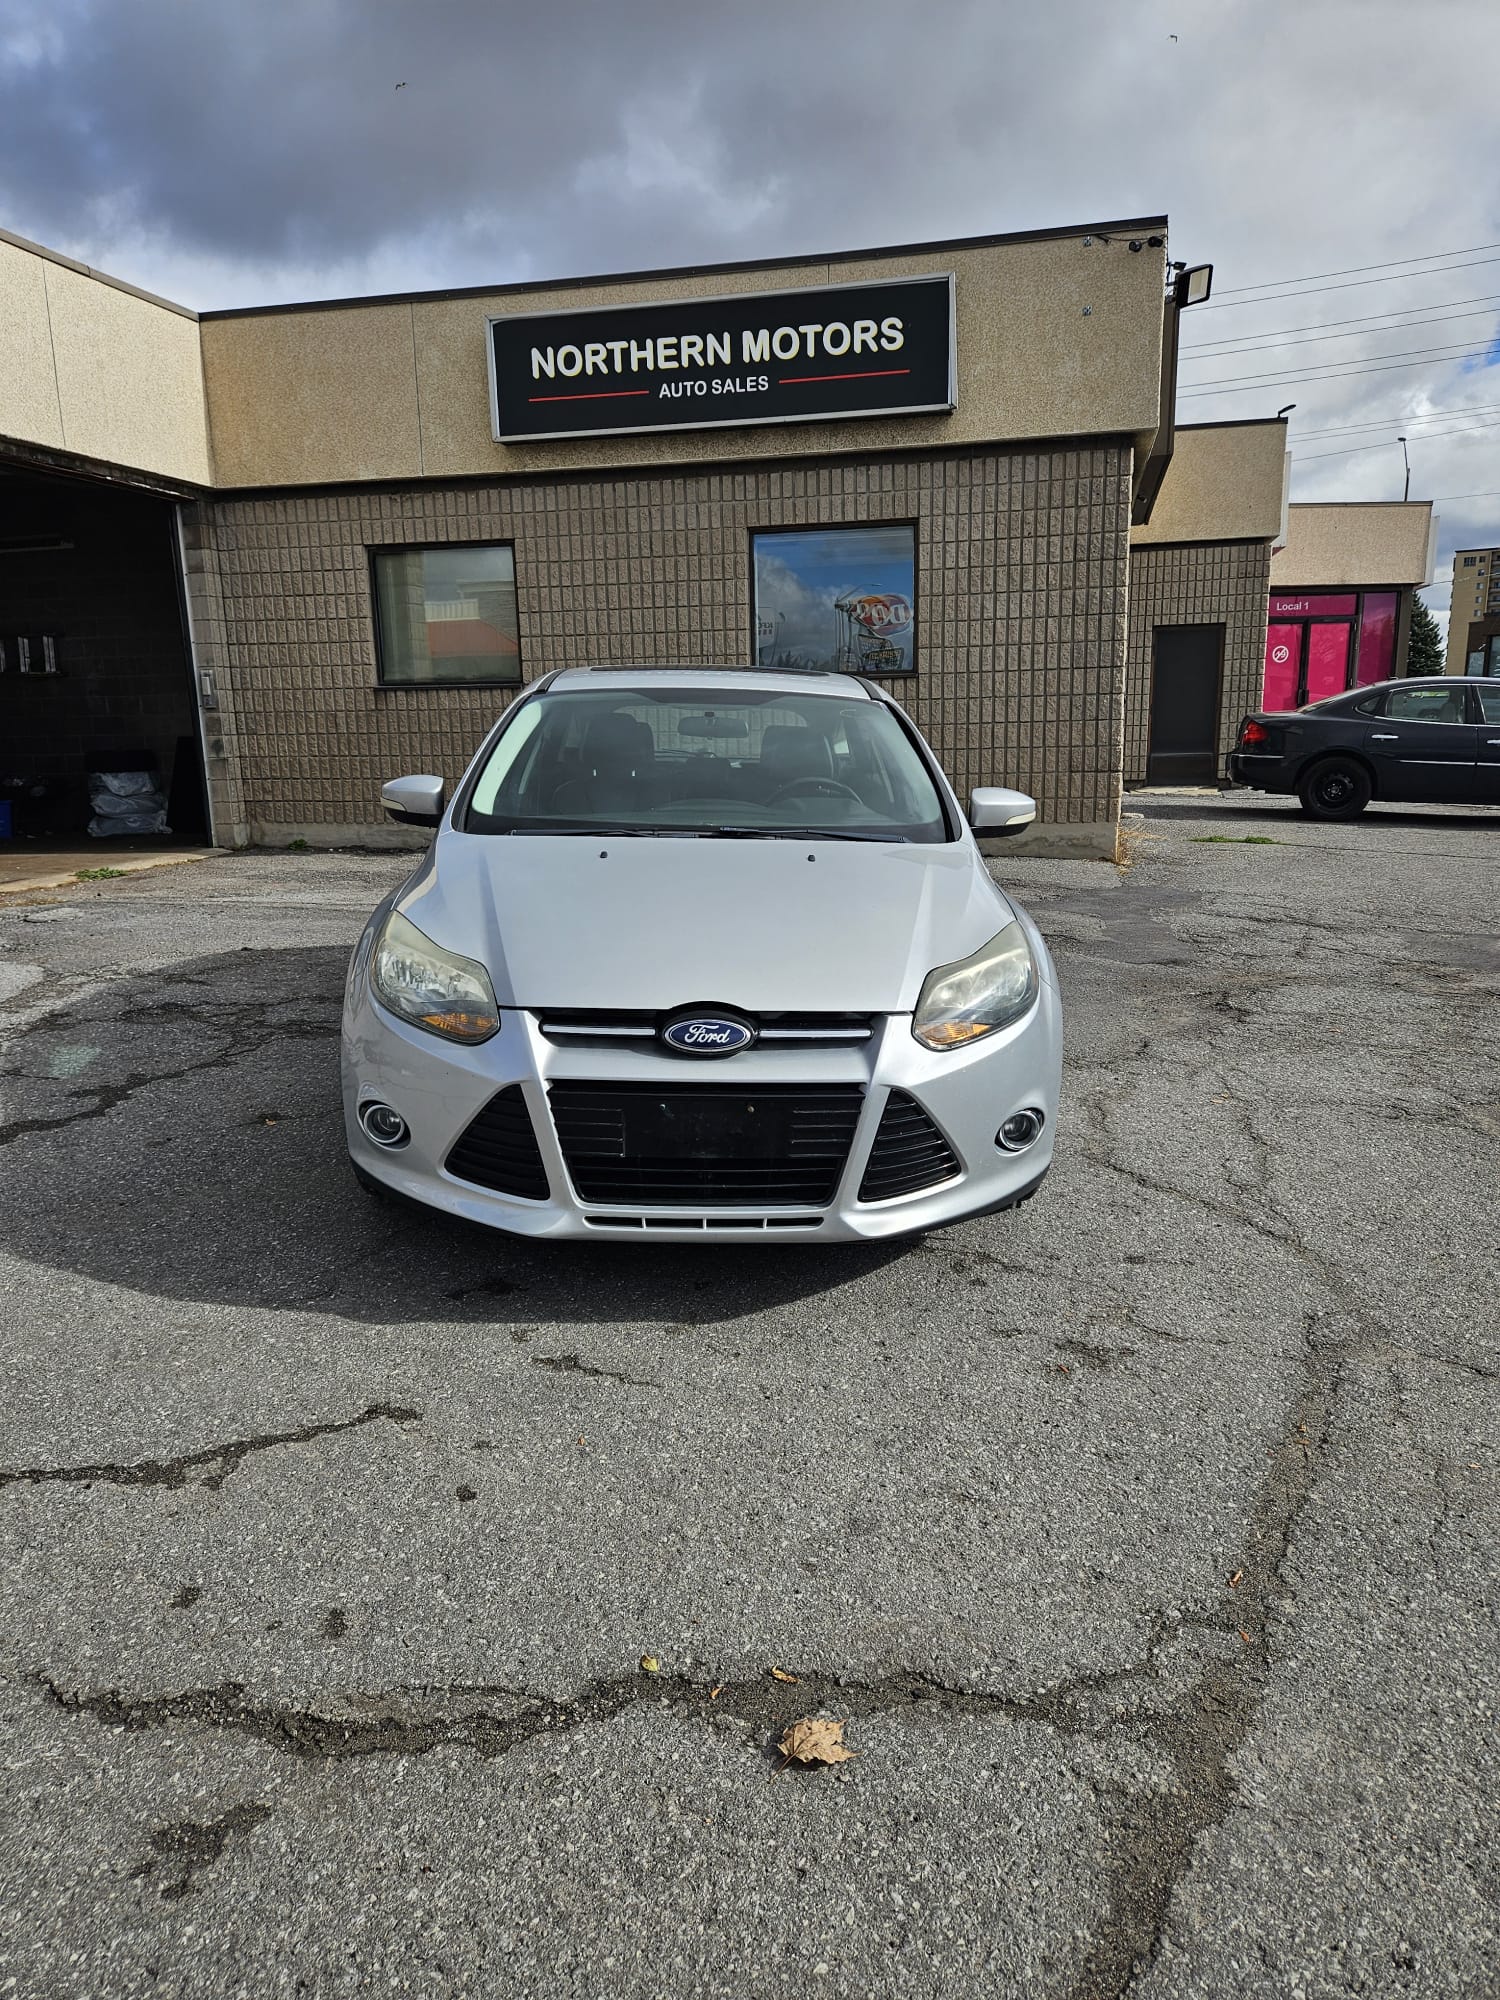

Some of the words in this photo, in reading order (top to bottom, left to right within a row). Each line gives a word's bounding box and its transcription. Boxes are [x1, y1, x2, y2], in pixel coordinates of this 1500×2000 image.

[530, 331, 731, 380] NORTHERN
[742, 316, 905, 363] MOTORS
[658, 379, 708, 399] AUTO
[711, 375, 770, 395] SALES
[1276, 602, 1302, 611] Local
[1304, 602, 1309, 610] 1
[684, 1024, 731, 1043] Ford
